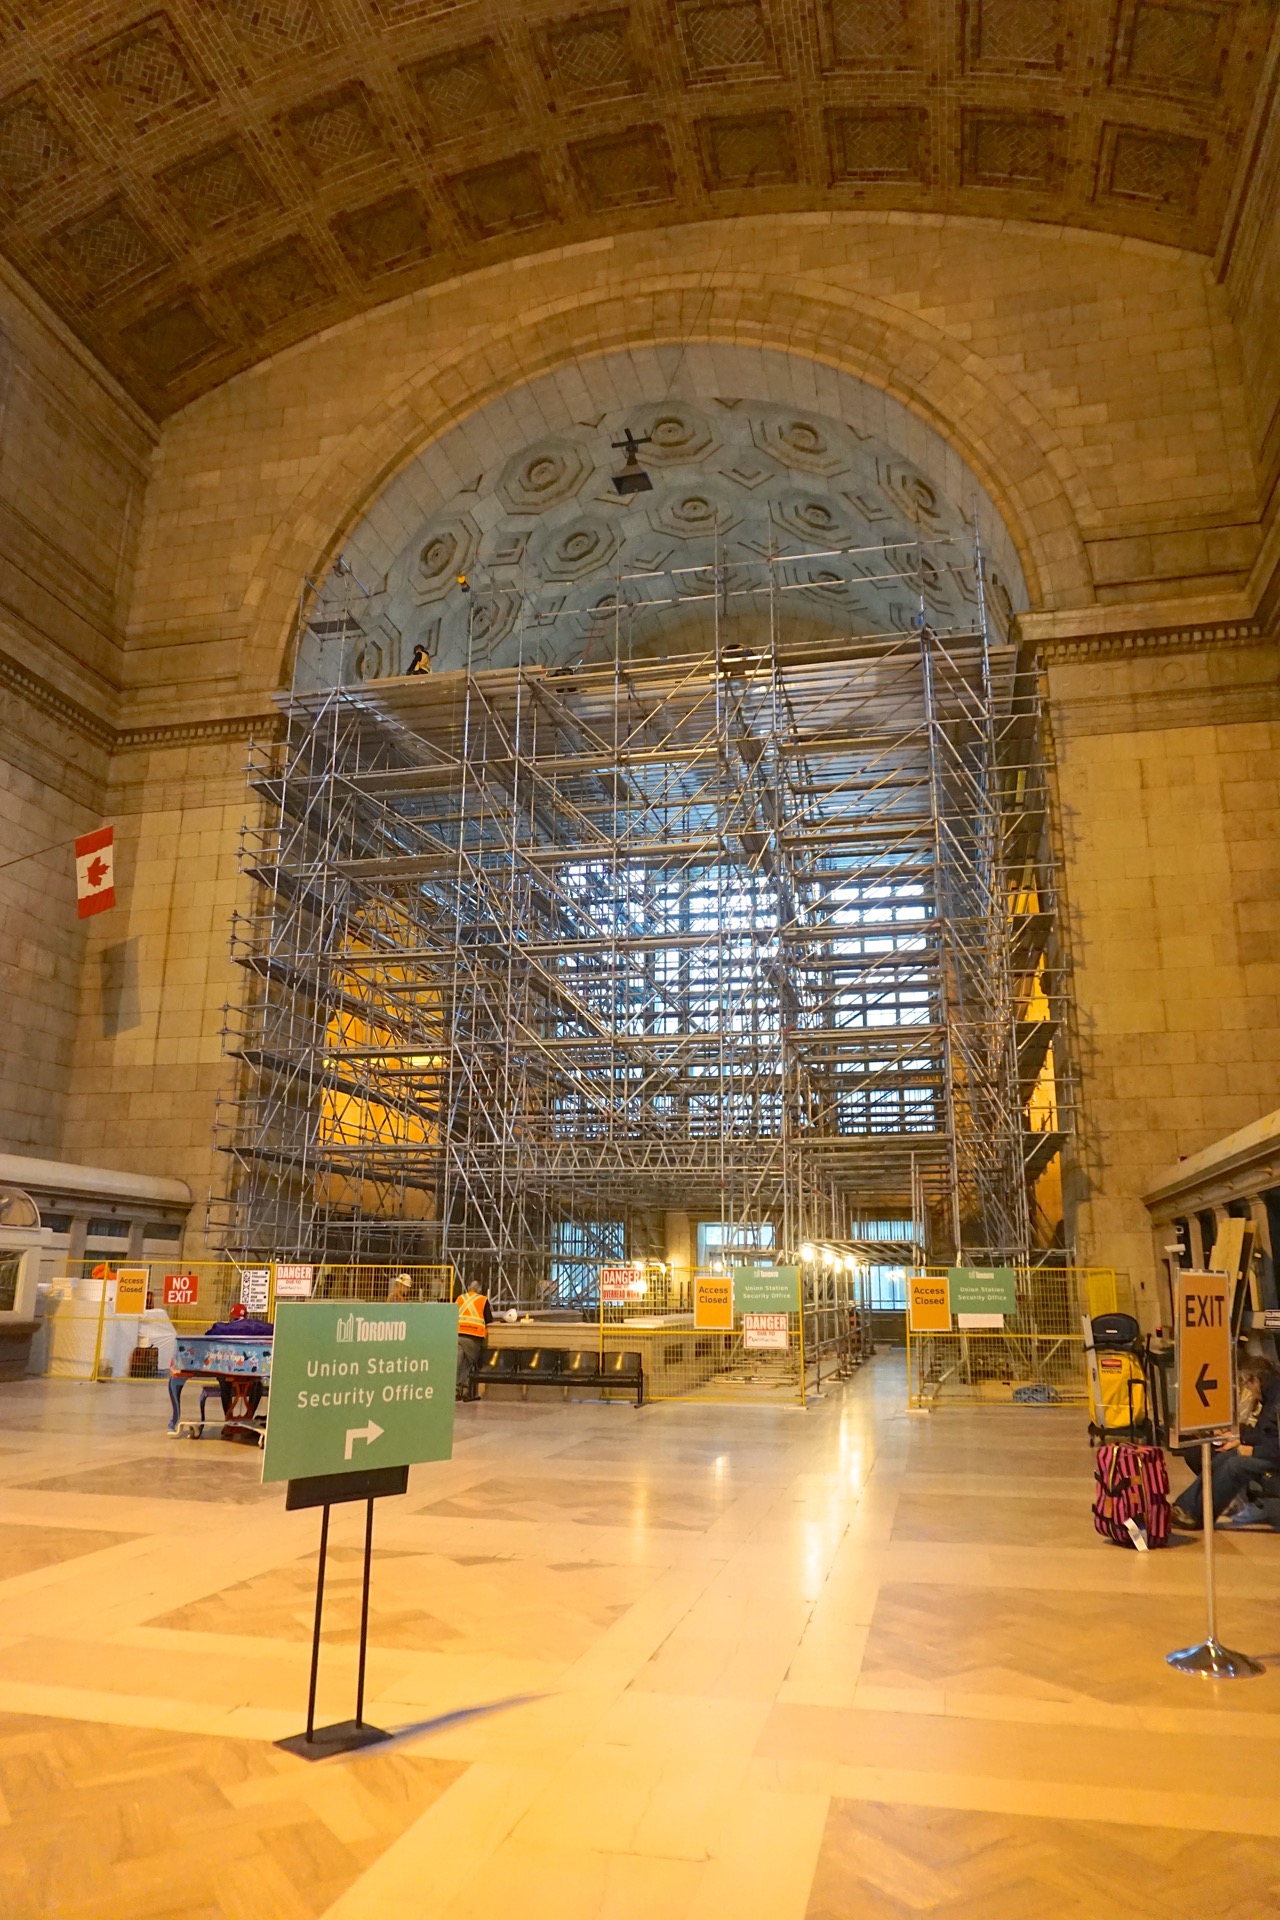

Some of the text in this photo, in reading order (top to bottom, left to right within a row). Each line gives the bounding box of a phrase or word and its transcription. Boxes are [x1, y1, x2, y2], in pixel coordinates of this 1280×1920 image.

[278, 1267, 311, 1279] DANGER
[604, 1271, 640, 1284] DANGER
[172, 1277, 189, 1290] NO
[699, 1286, 728, 1294] Access
[168, 1290, 192, 1302] EXIT
[604, 1290, 625, 1298] OVERHEAD
[699, 1296, 728, 1304] Closed
[1186, 1295, 1225, 1328] EXIT
[356, 1317, 406, 1342] TORONTO
[746, 1316, 786, 1330] DANGER
[307, 1356, 429, 1378] Union Station
[298, 1384, 434, 1408] Security Office
